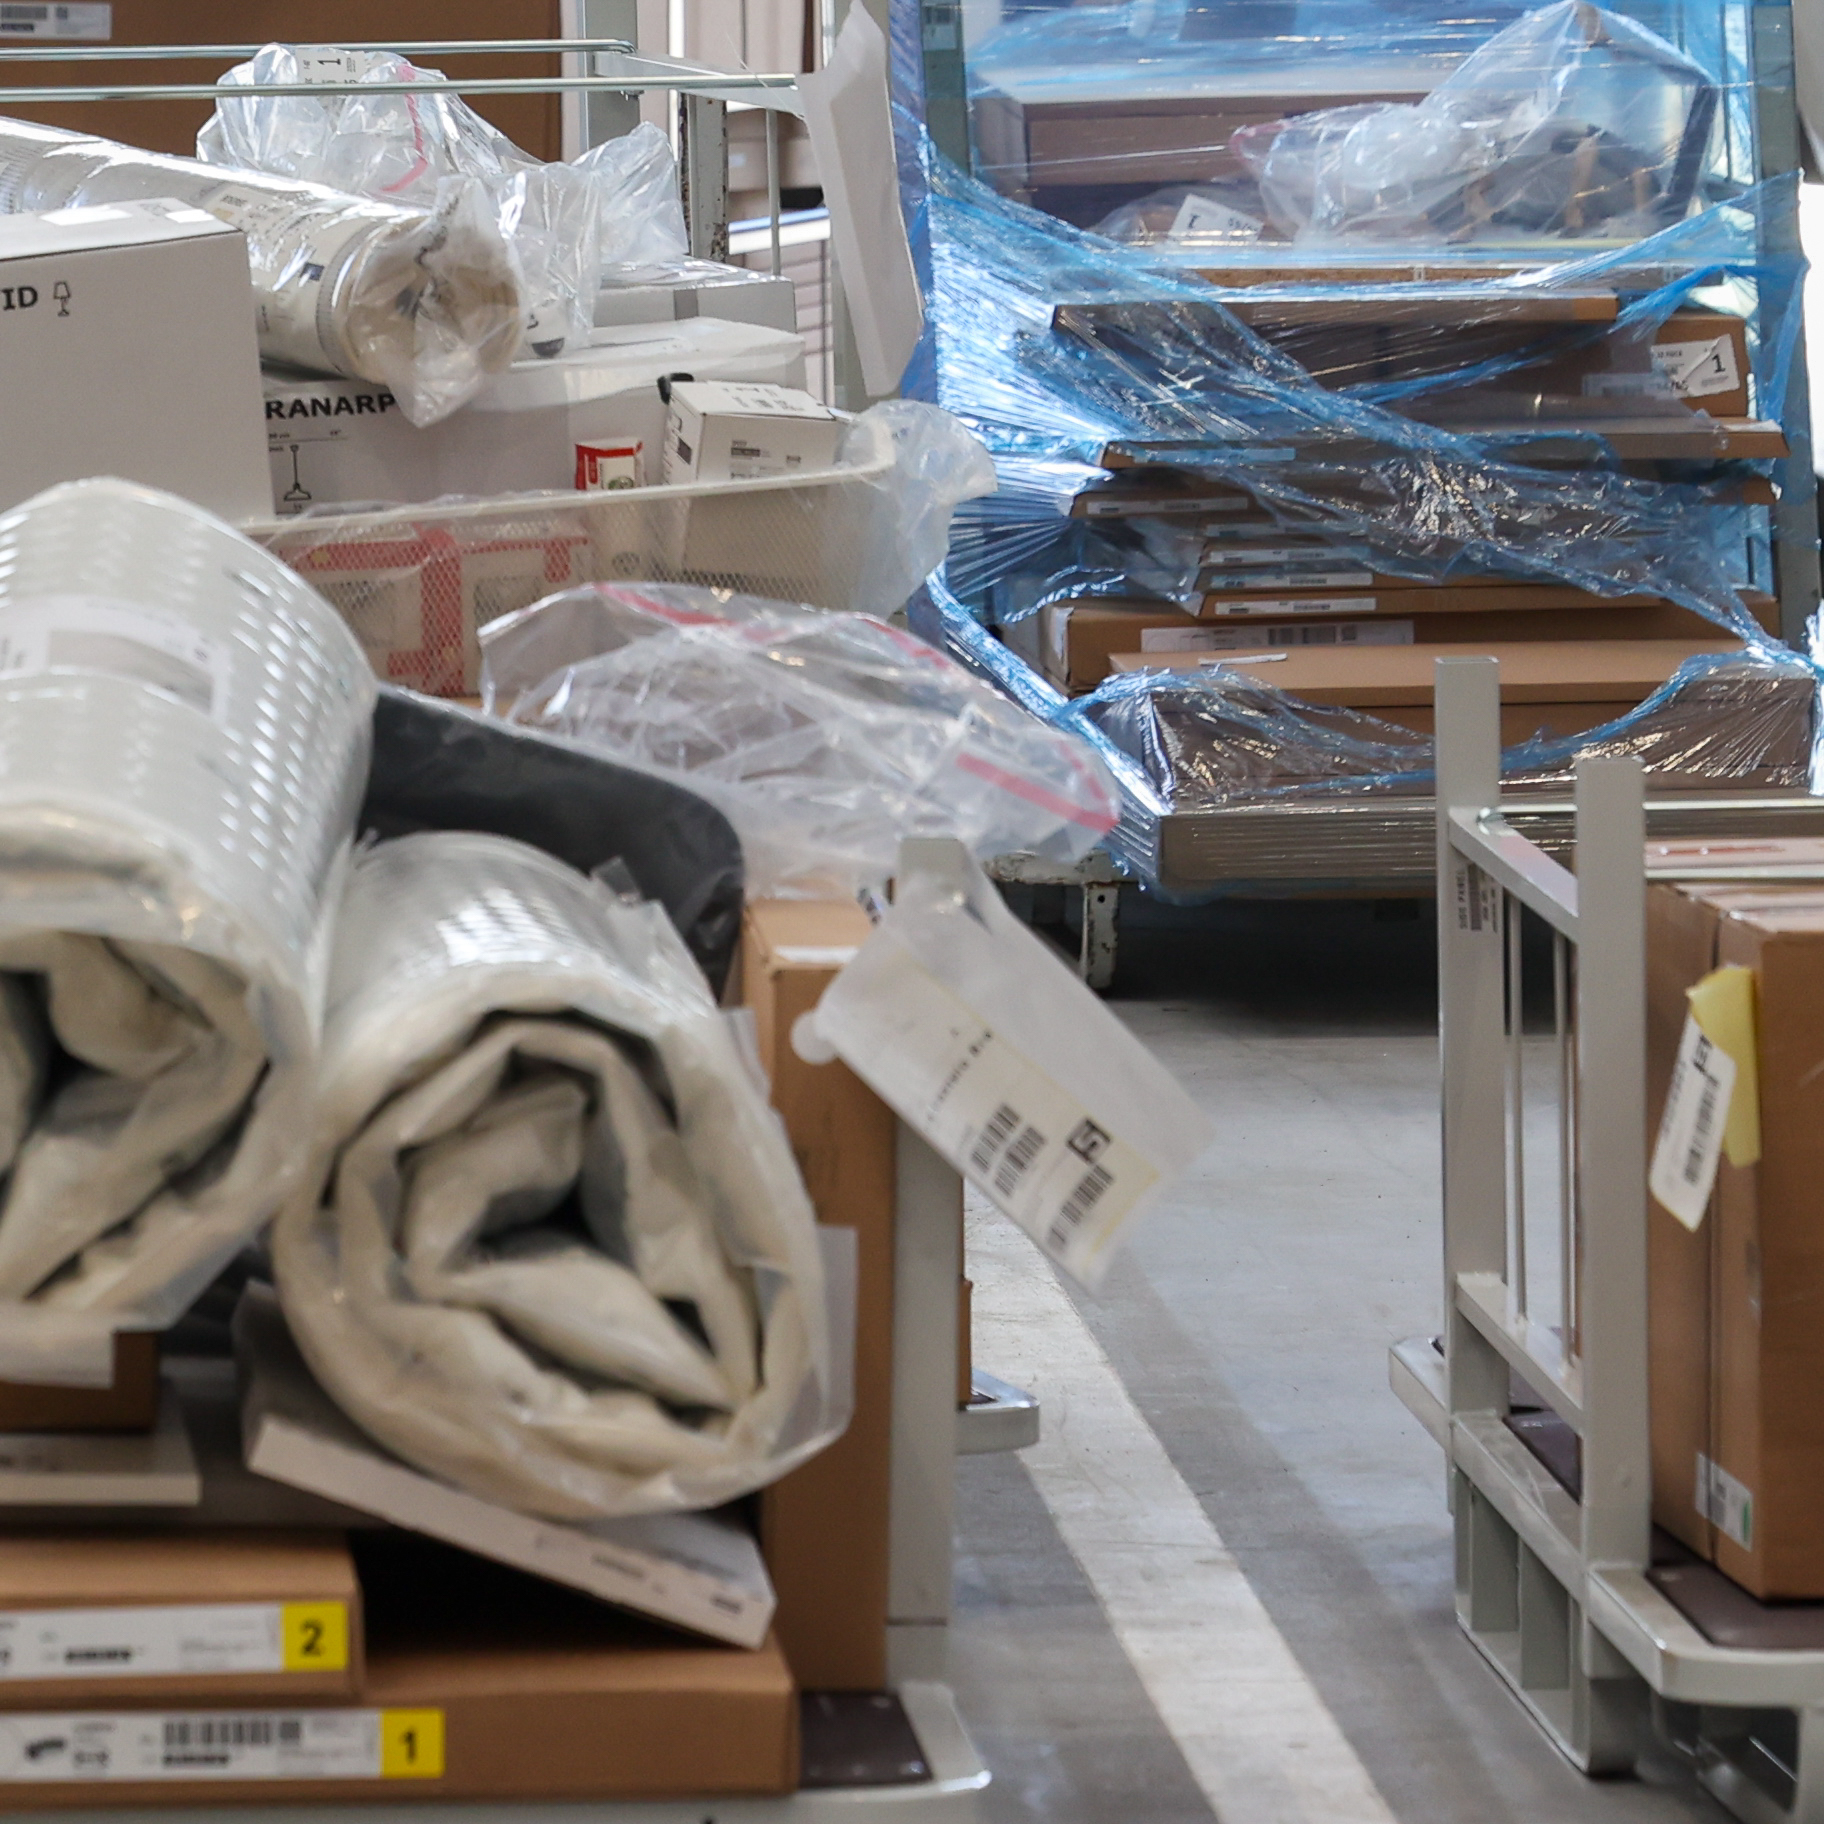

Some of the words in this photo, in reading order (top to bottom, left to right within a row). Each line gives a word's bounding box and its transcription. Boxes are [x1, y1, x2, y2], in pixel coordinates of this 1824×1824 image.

[1711, 353, 1726, 374] 1
[265, 392, 397, 421] RANARP
[300, 1620, 325, 1656] 2
[399, 1730, 418, 1765] 1
